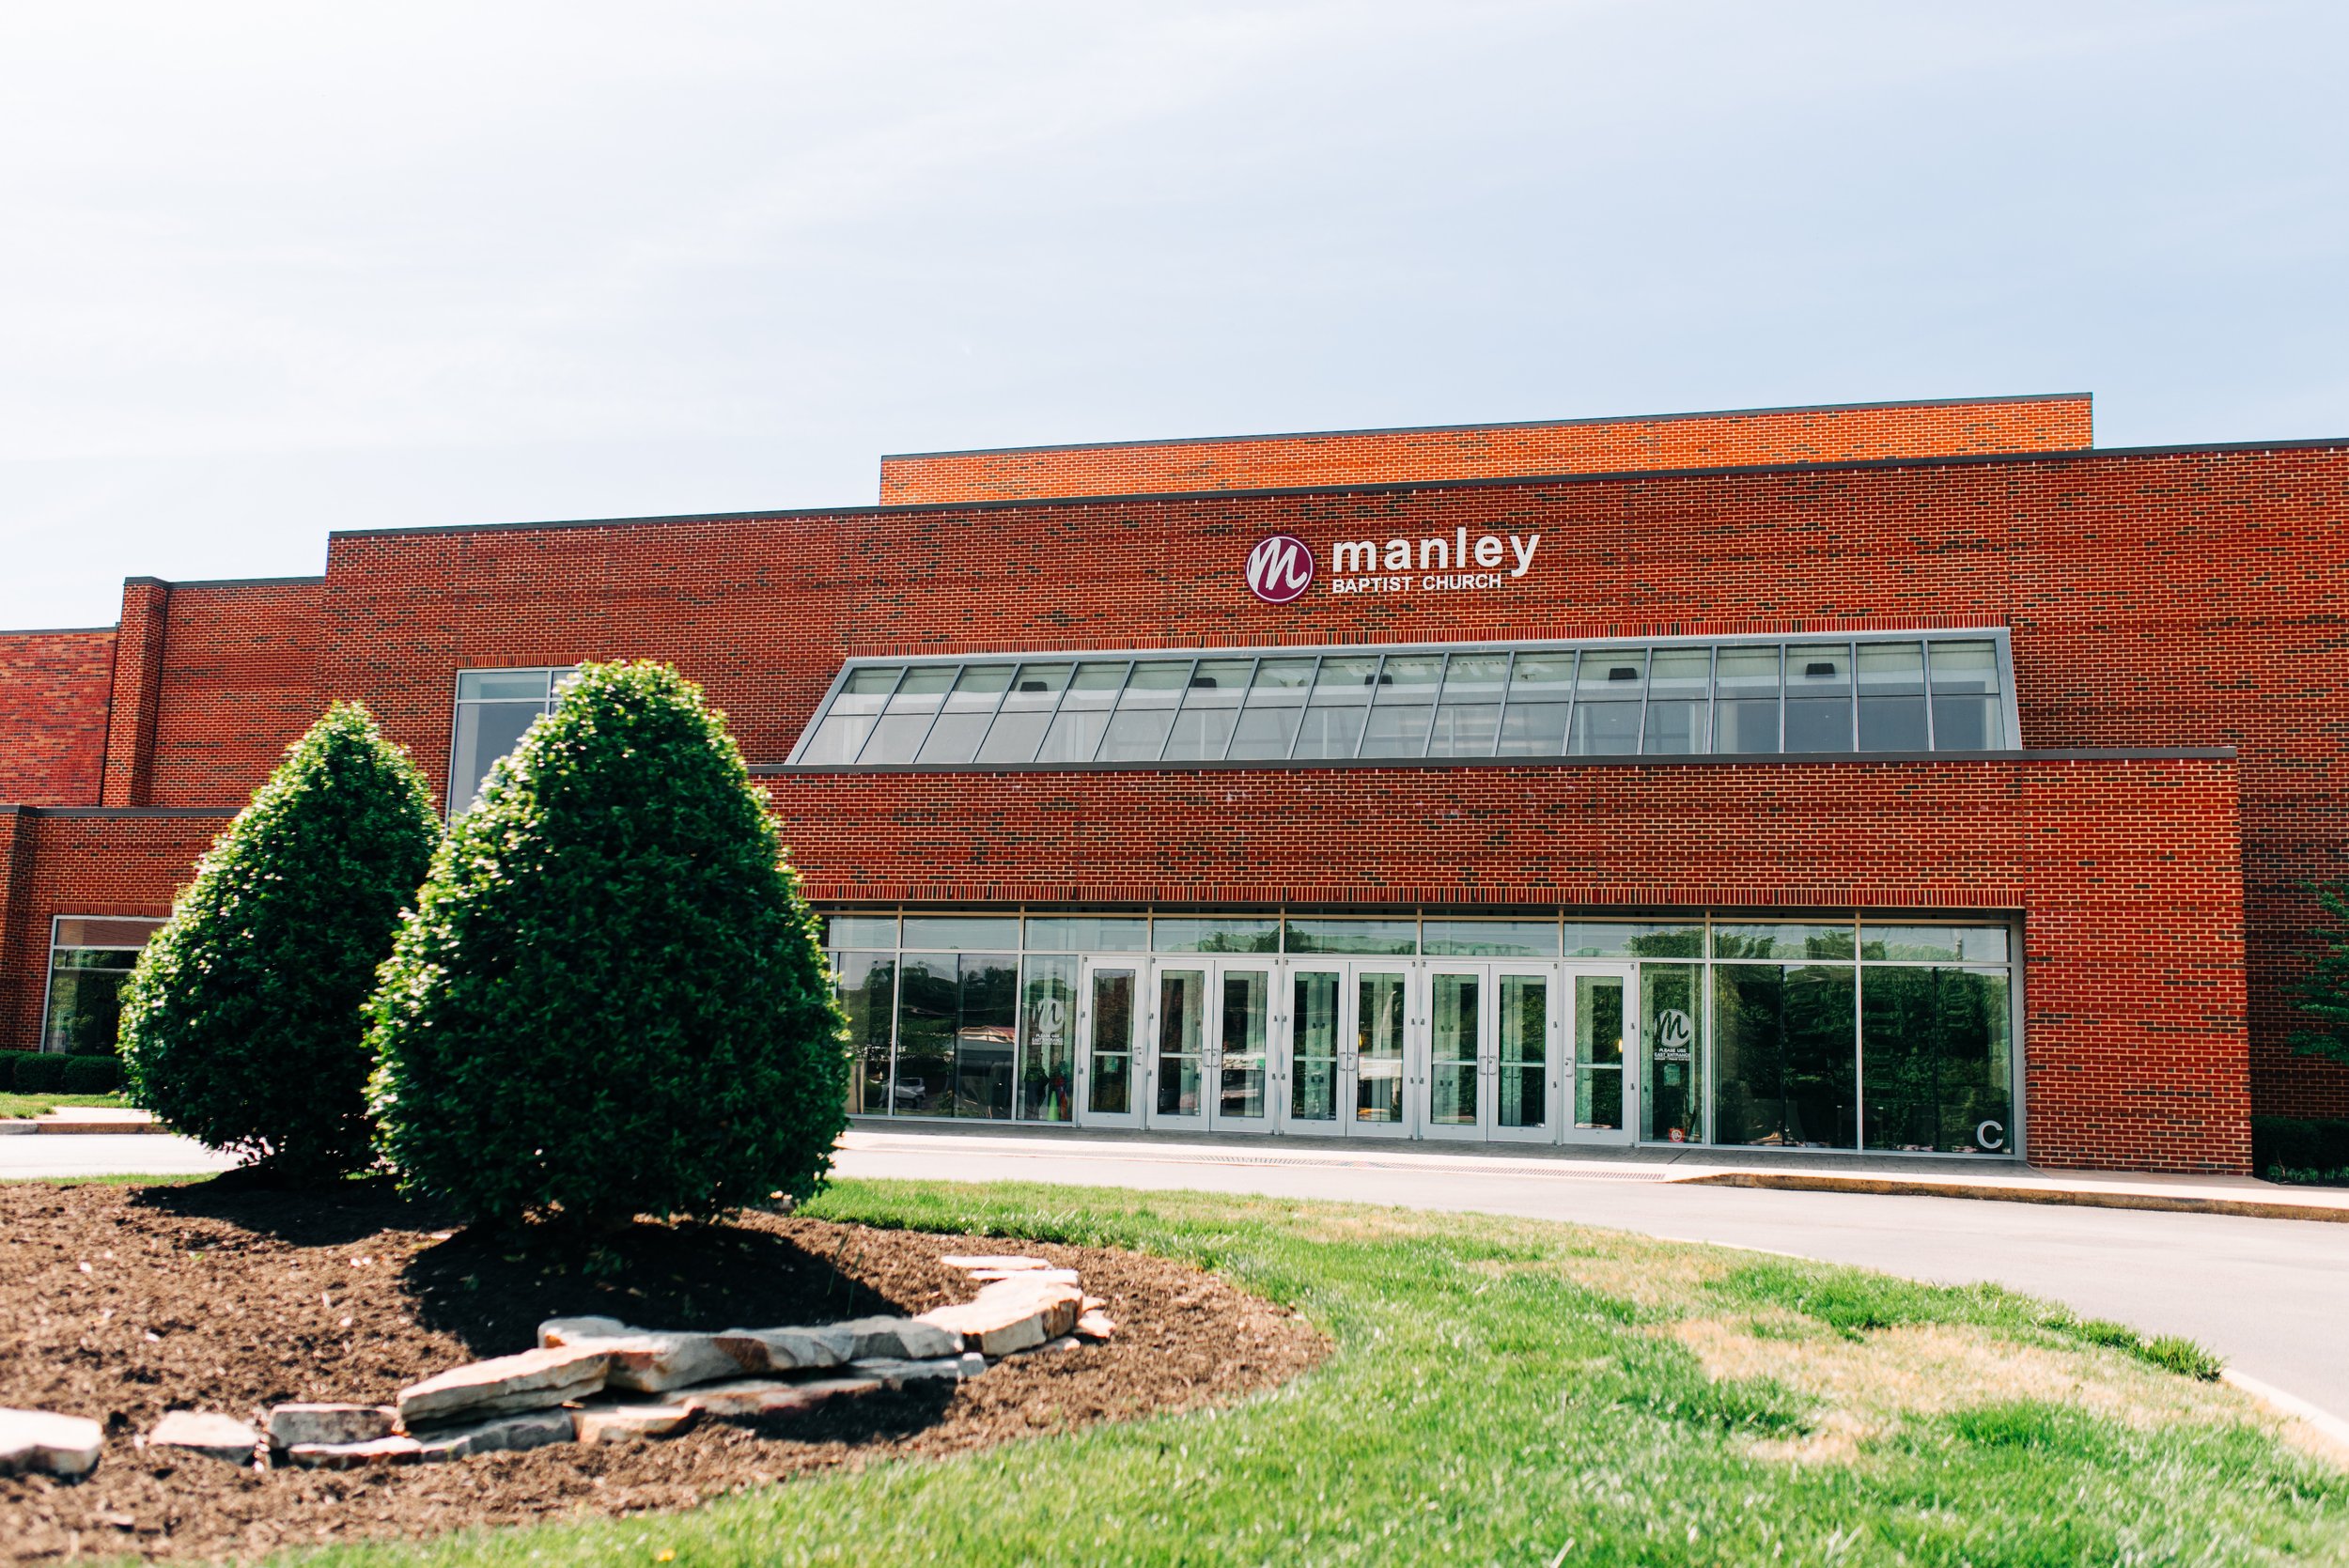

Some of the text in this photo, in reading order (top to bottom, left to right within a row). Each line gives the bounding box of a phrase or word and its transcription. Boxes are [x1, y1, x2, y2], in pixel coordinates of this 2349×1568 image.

[1333, 527, 1540, 577] manley
[1332, 574, 1501, 594] BAPTIST CHURCH
[1977, 1120, 2003, 1149] C
